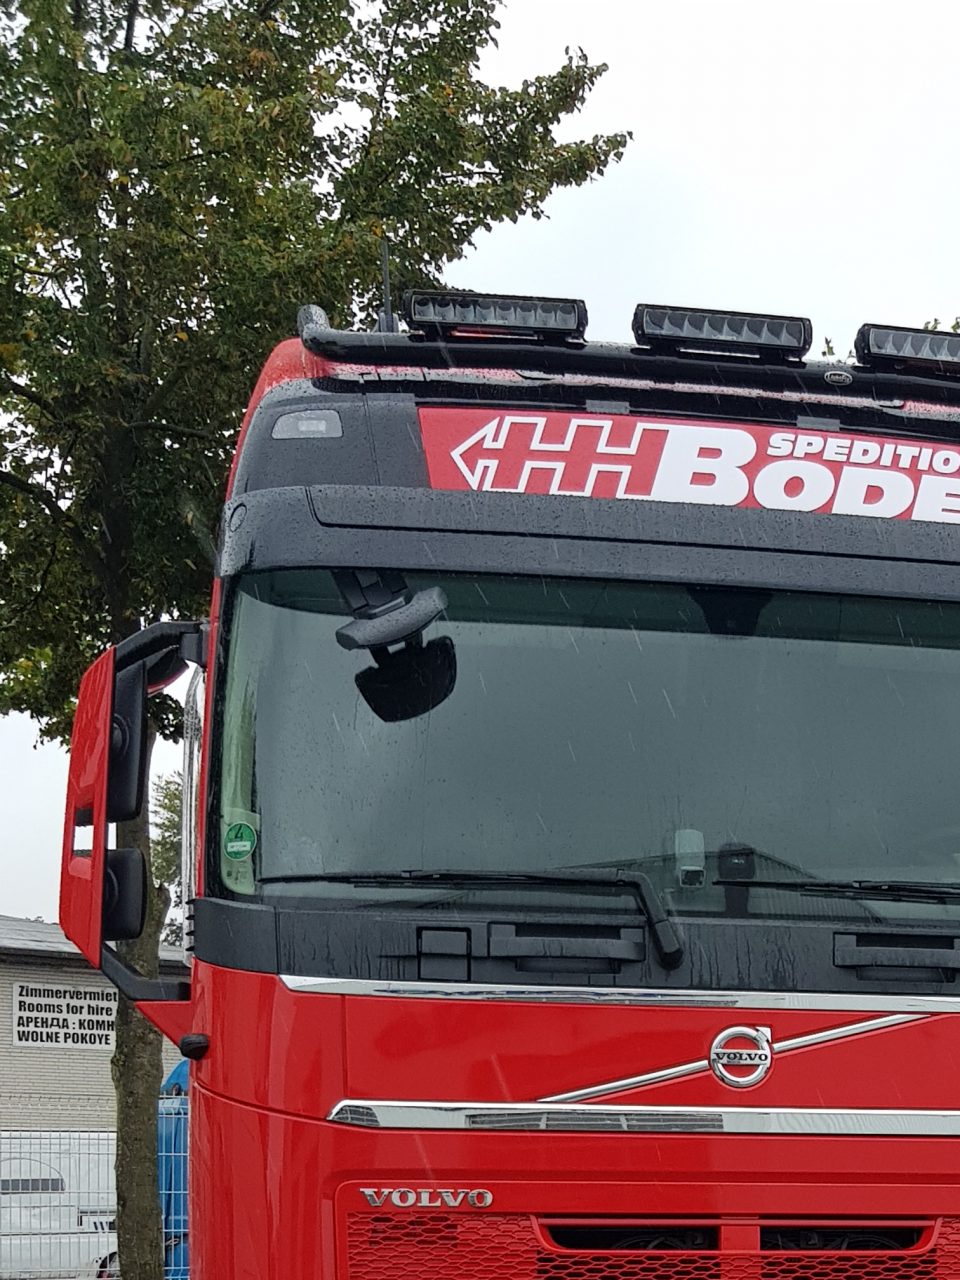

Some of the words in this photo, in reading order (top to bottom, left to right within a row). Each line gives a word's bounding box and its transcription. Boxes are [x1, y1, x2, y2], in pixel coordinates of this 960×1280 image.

[18, 985, 118, 1003] Zimmervermiet
[18, 1000, 63, 1014] Rooms
[66, 1003, 85, 1015] for
[87, 1004, 113, 1016] hire
[17, 1016, 69, 1030] АРЕНДА
[78, 1019, 115, 1031] КОМН
[17, 1030, 61, 1043] WOLNE
[63, 1032, 111, 1045] POKOYE
[713, 1052, 768, 1062] VOLVO
[359, 1187, 494, 1207] VOLVO
